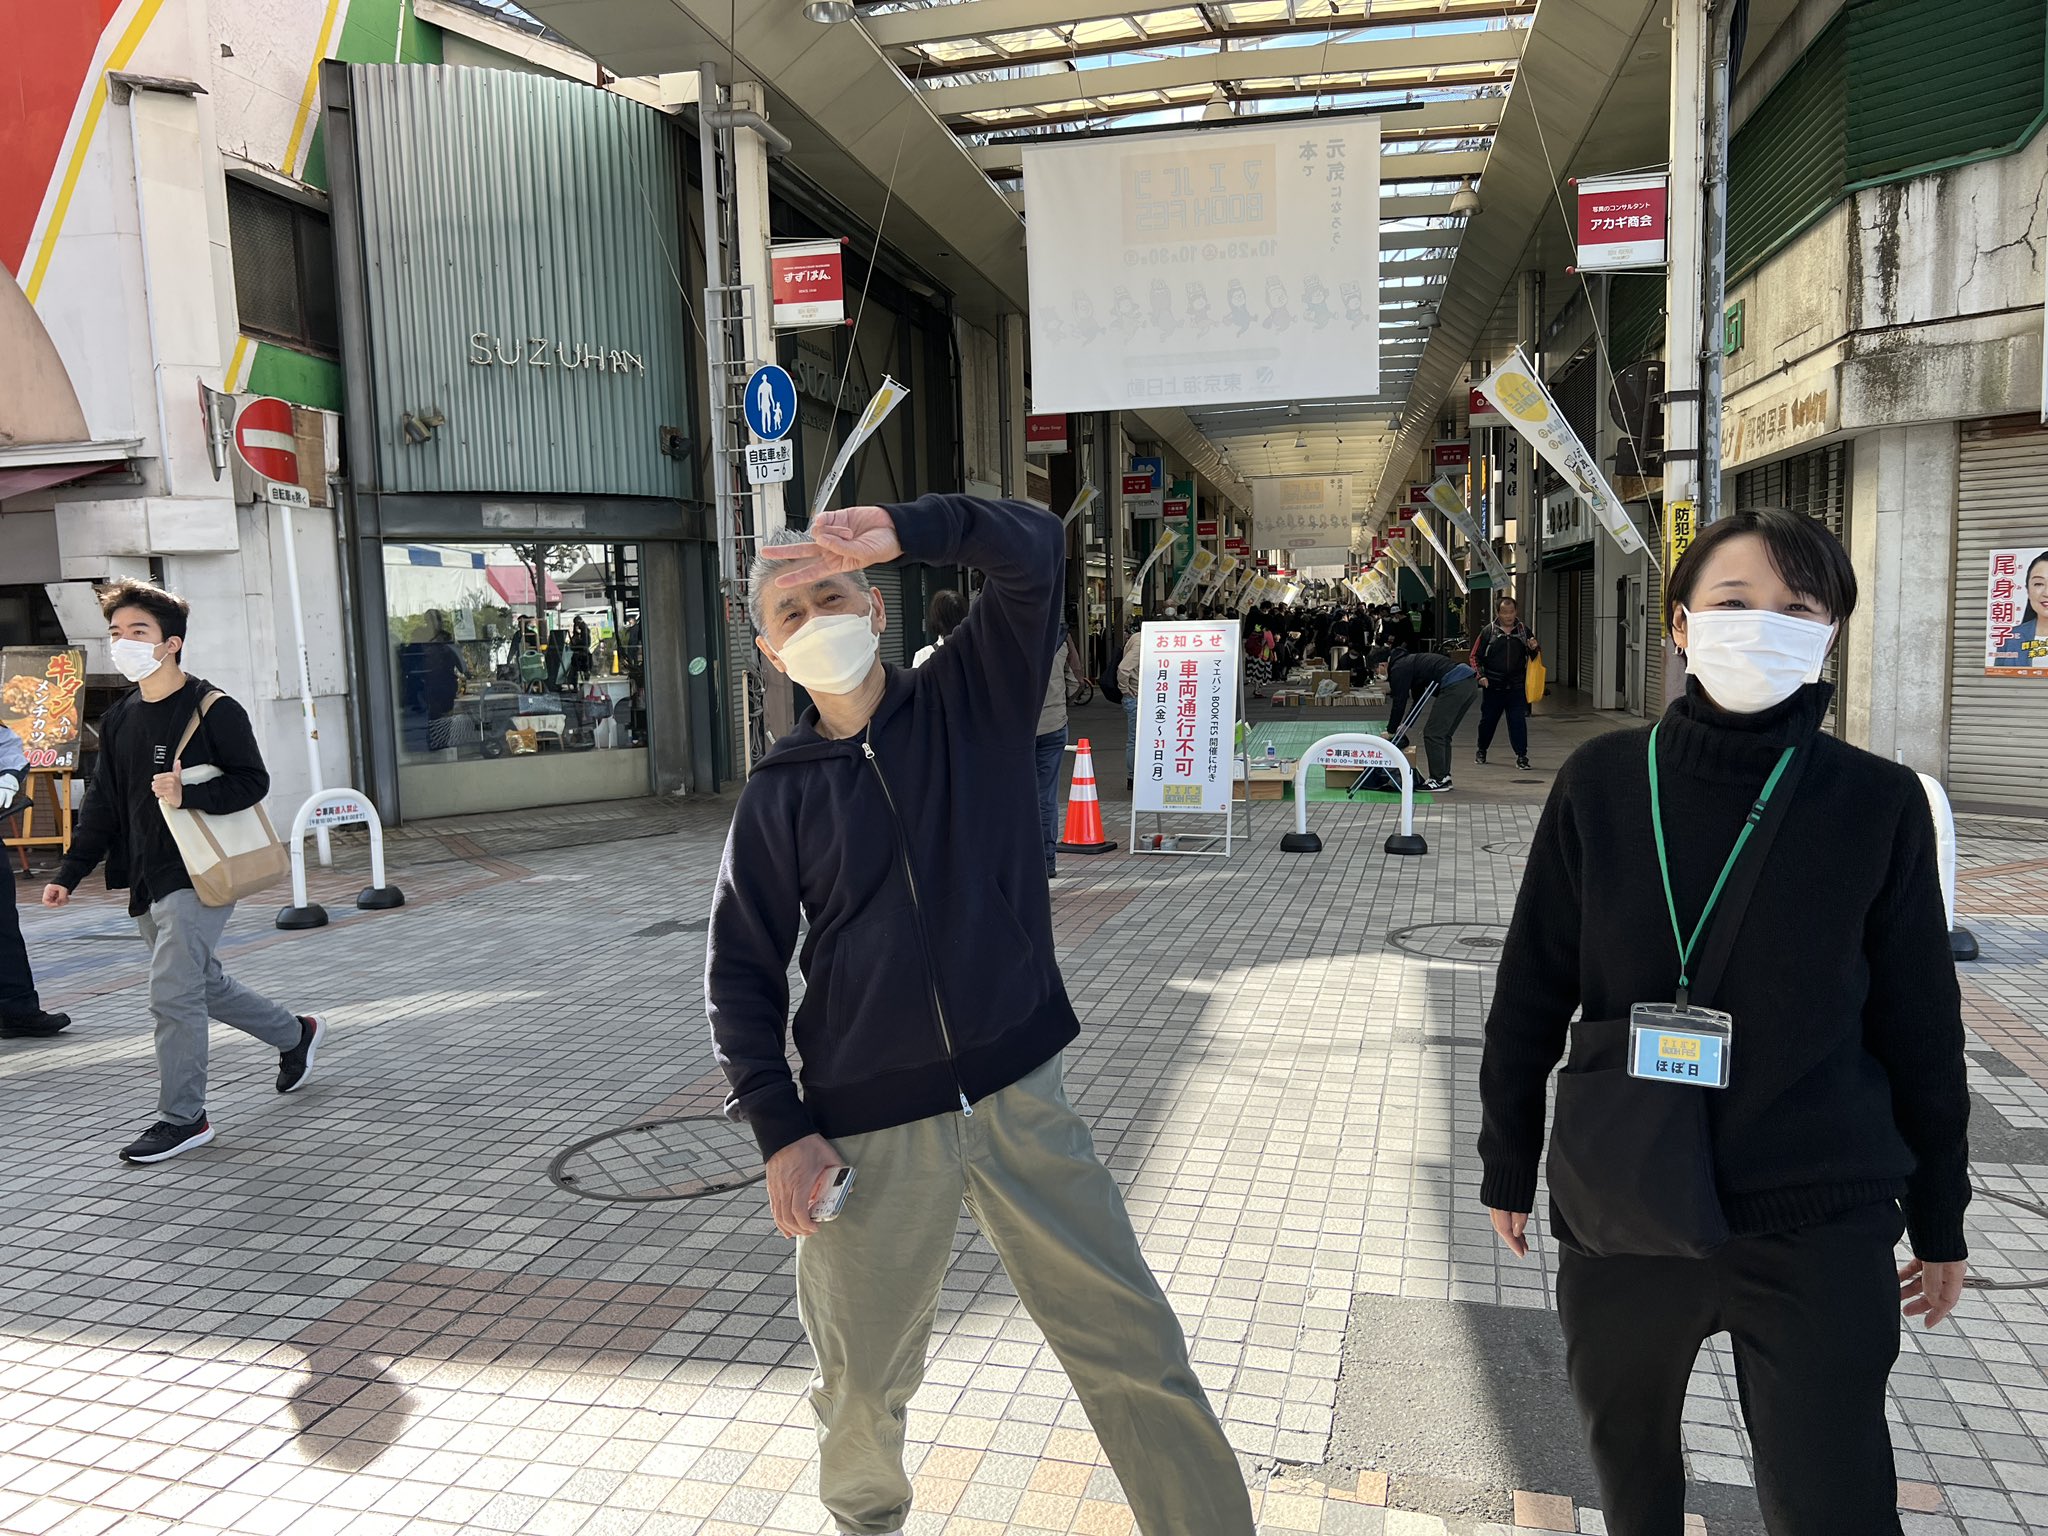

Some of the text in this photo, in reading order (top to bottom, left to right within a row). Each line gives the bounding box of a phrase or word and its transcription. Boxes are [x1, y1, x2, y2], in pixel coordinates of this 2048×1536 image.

[1590, 214, 1653, 231] アカギ商会
[470, 332, 646, 377] SUZUHAN
[1991, 554, 2016, 648] 尾身朝子
[1156, 634, 1223, 648] お知らせ
[46, 654, 83, 719] 牛タン
[1212, 659, 1222, 694] マエバシ
[31, 680, 49, 742] メンチカツ
[1175, 659, 1199, 777] 車両通行不可
[1210, 696, 1220, 720] BOOK
[1209, 721, 1219, 736] FES
[1335, 749, 1383, 759] 車両進入禁止
[1655, 1059, 1699, 1077] ほぼ日
